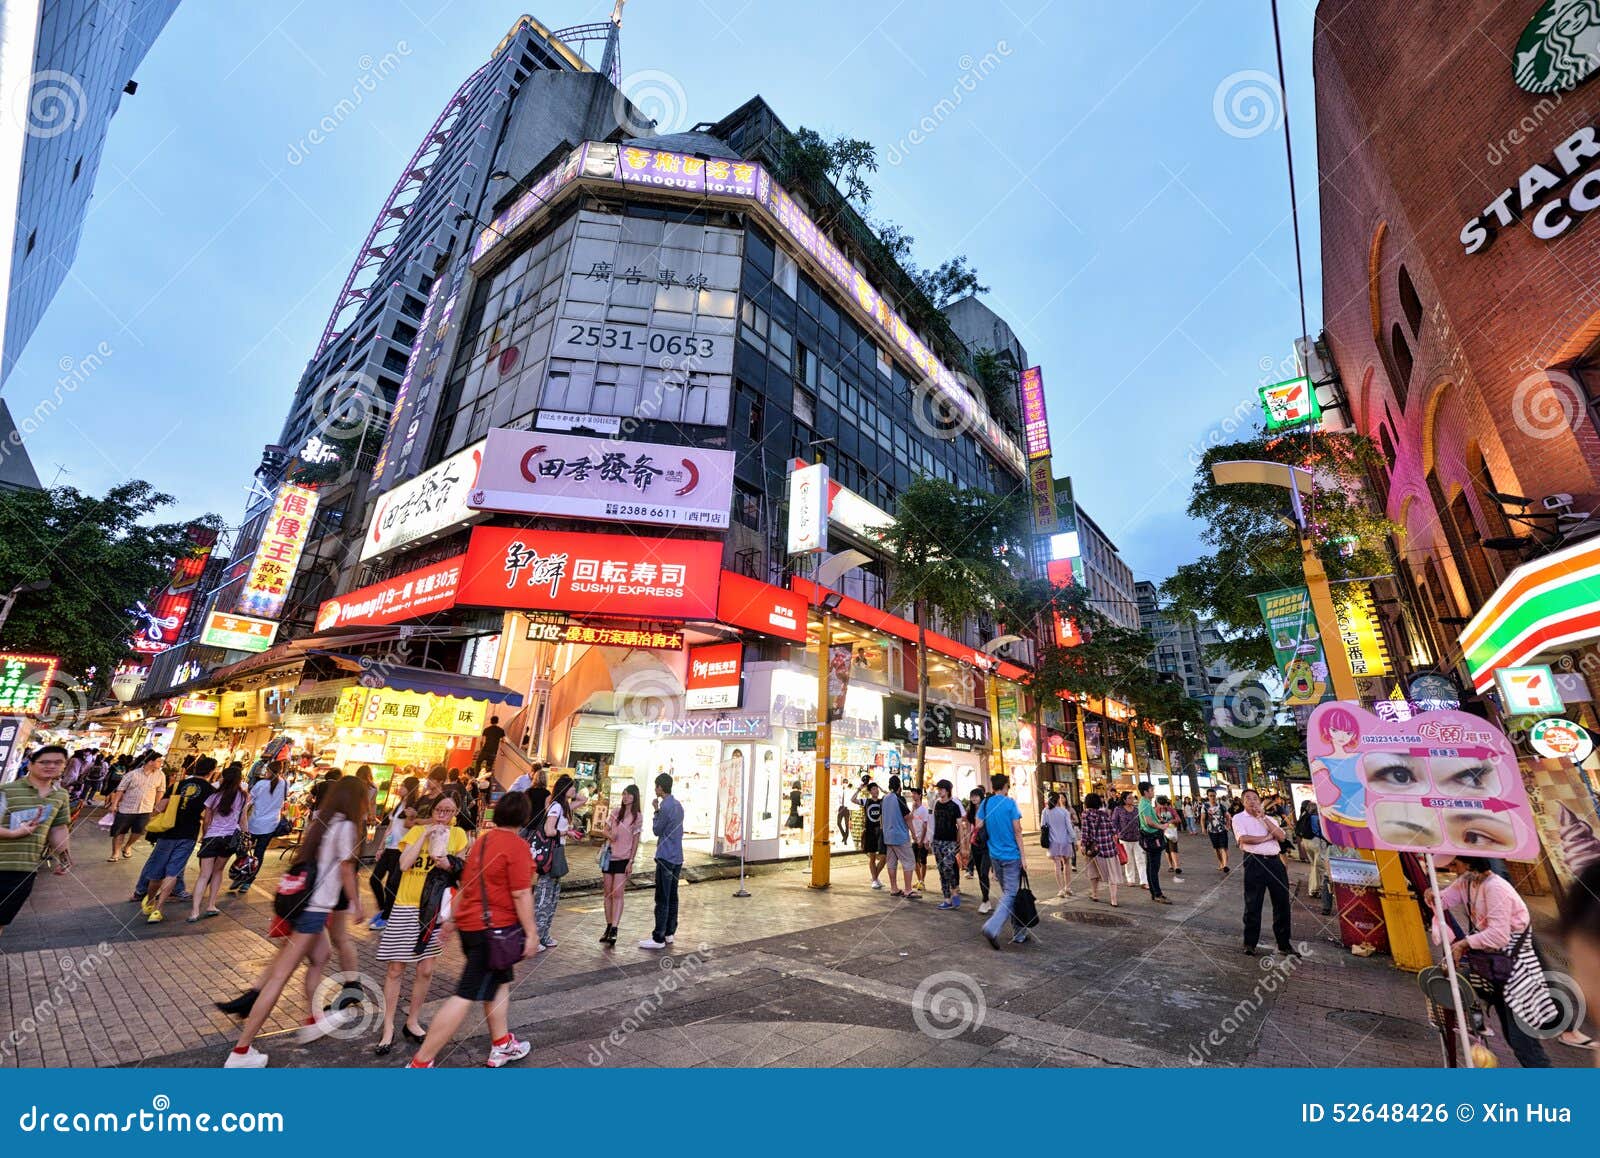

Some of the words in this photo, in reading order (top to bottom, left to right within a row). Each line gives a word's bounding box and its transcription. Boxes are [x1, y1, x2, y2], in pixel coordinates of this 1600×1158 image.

[620, 171, 697, 189] BAROQUE
[703, 181, 755, 196] HOTEL
[1459, 126, 1600, 255] STAR
[585, 260, 712, 293] 廣告專線
[567, 325, 715, 358] 2531-0653
[269, 492, 308, 564] 偶像王
[620, 505, 648, 517] 2388
[650, 507, 676, 518] 6611
[688, 511, 721, 524] 西門店
[572, 558, 687, 587] 回転寿司
[571, 582, 614, 594] SUSHI
[618, 583, 684, 598] EXPRESS
[382, 702, 420, 718] 萬國
[458, 711, 475, 723] 味
